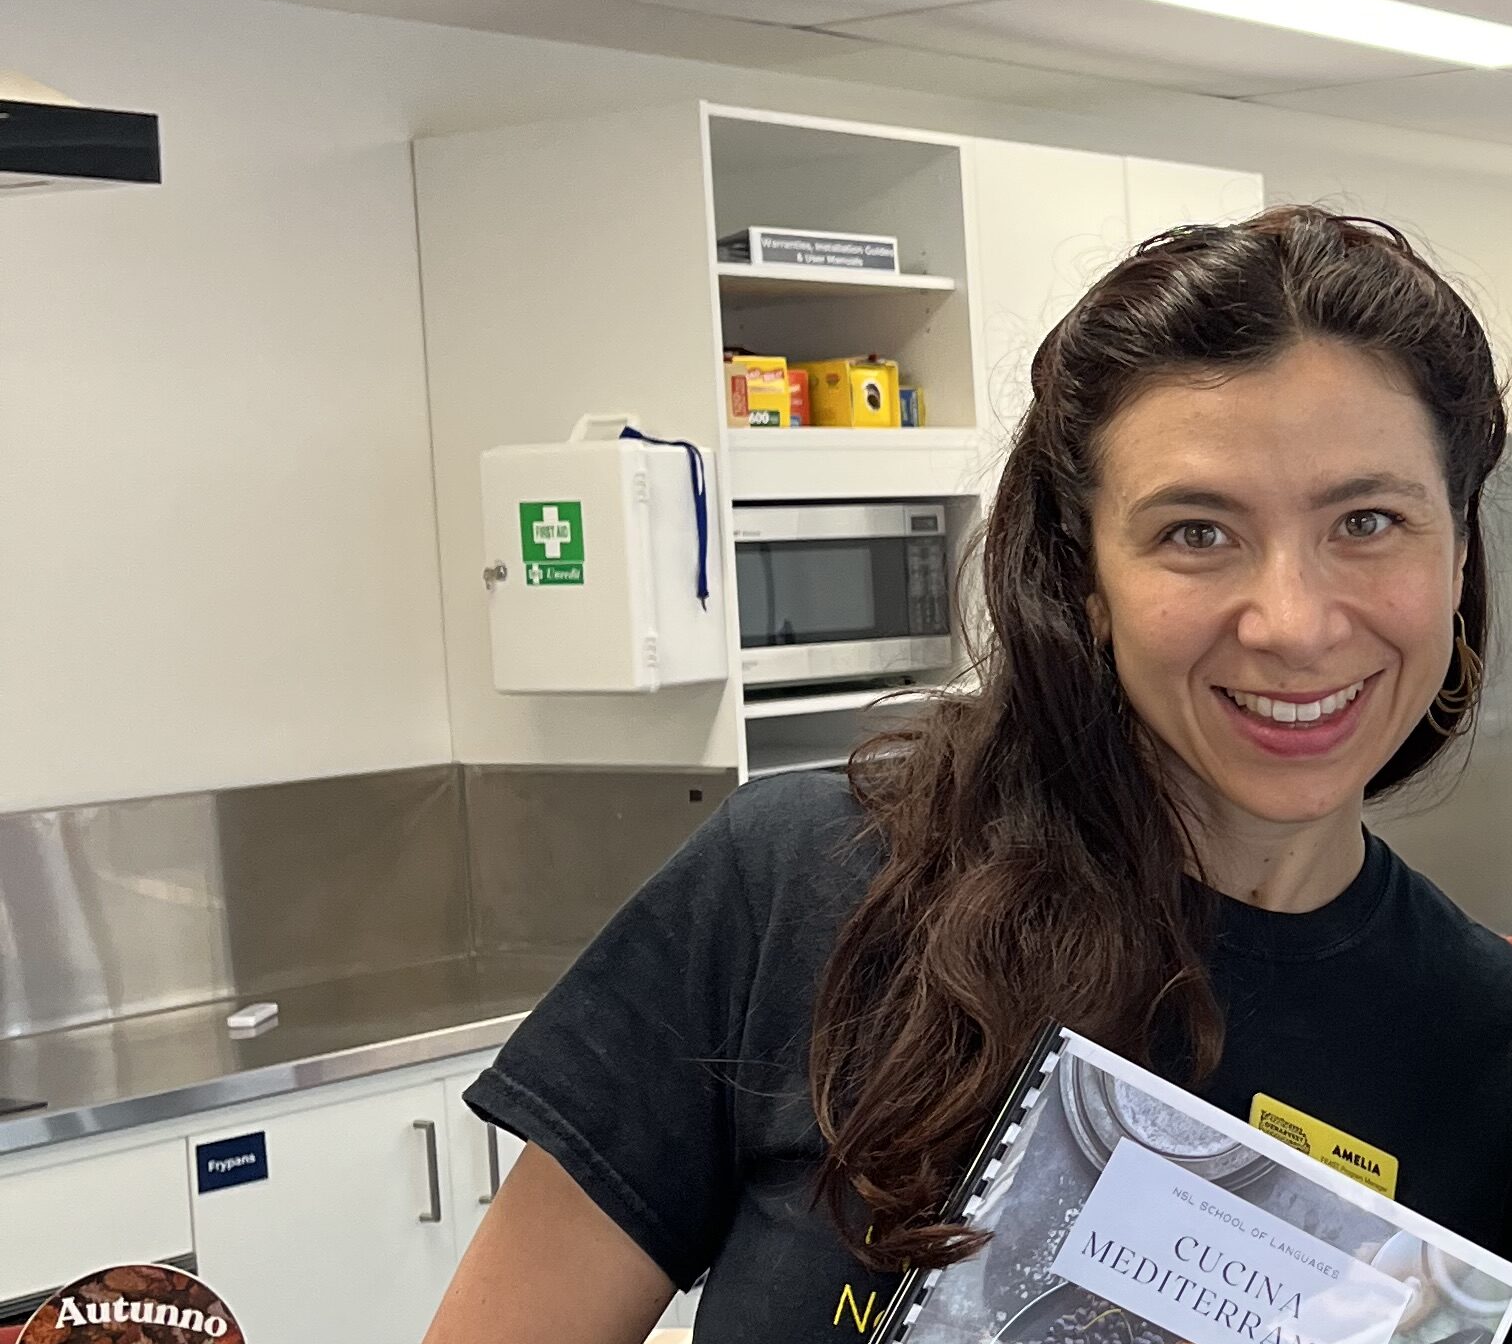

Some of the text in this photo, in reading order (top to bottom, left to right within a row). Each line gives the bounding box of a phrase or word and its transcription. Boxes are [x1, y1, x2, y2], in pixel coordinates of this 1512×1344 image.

[536, 525, 569, 539] FIRST AID
[208, 1153, 256, 1173] Frypans
[1332, 1145, 1381, 1177] AMELIA
[1172, 1187, 1340, 1280] NSL SCHOOL OF LANGUAGES
[1174, 1236, 1303, 1319] CUCINA
[55, 1296, 228, 1337] Autunno
